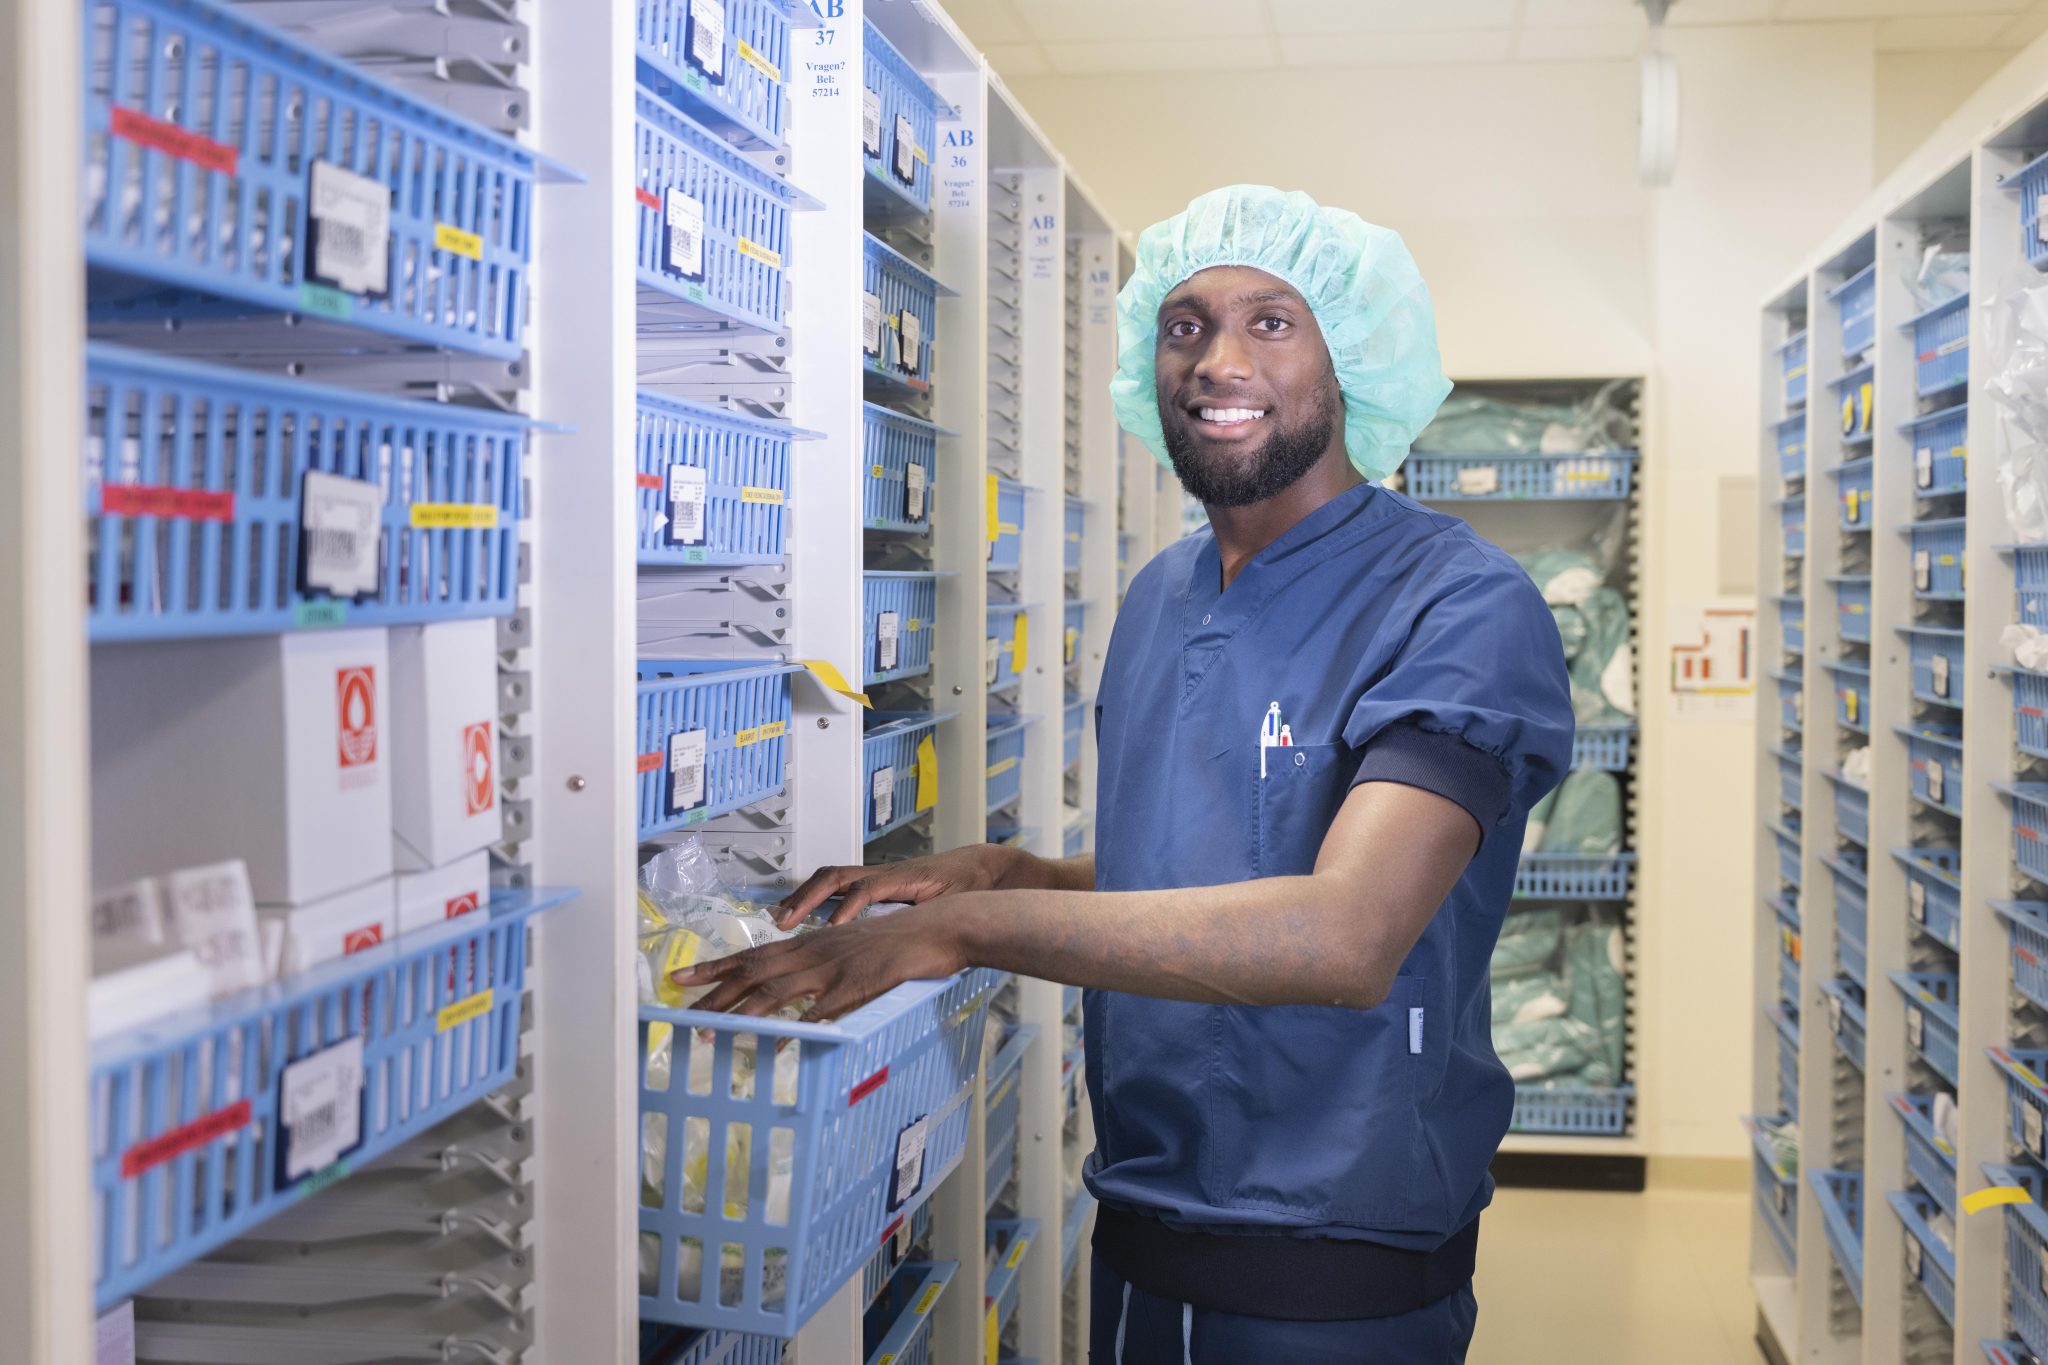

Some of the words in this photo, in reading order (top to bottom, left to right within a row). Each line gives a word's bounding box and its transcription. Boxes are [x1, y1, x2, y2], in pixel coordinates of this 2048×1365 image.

[815, 30, 835, 46] 37
[806, 61, 845, 72] Vragen?
[816, 75, 835, 84] Bel:
[812, 88, 840, 97] 57214
[943, 129, 974, 147] AB
[951, 155, 967, 168] 36
[1030, 215, 1055, 230] AB
